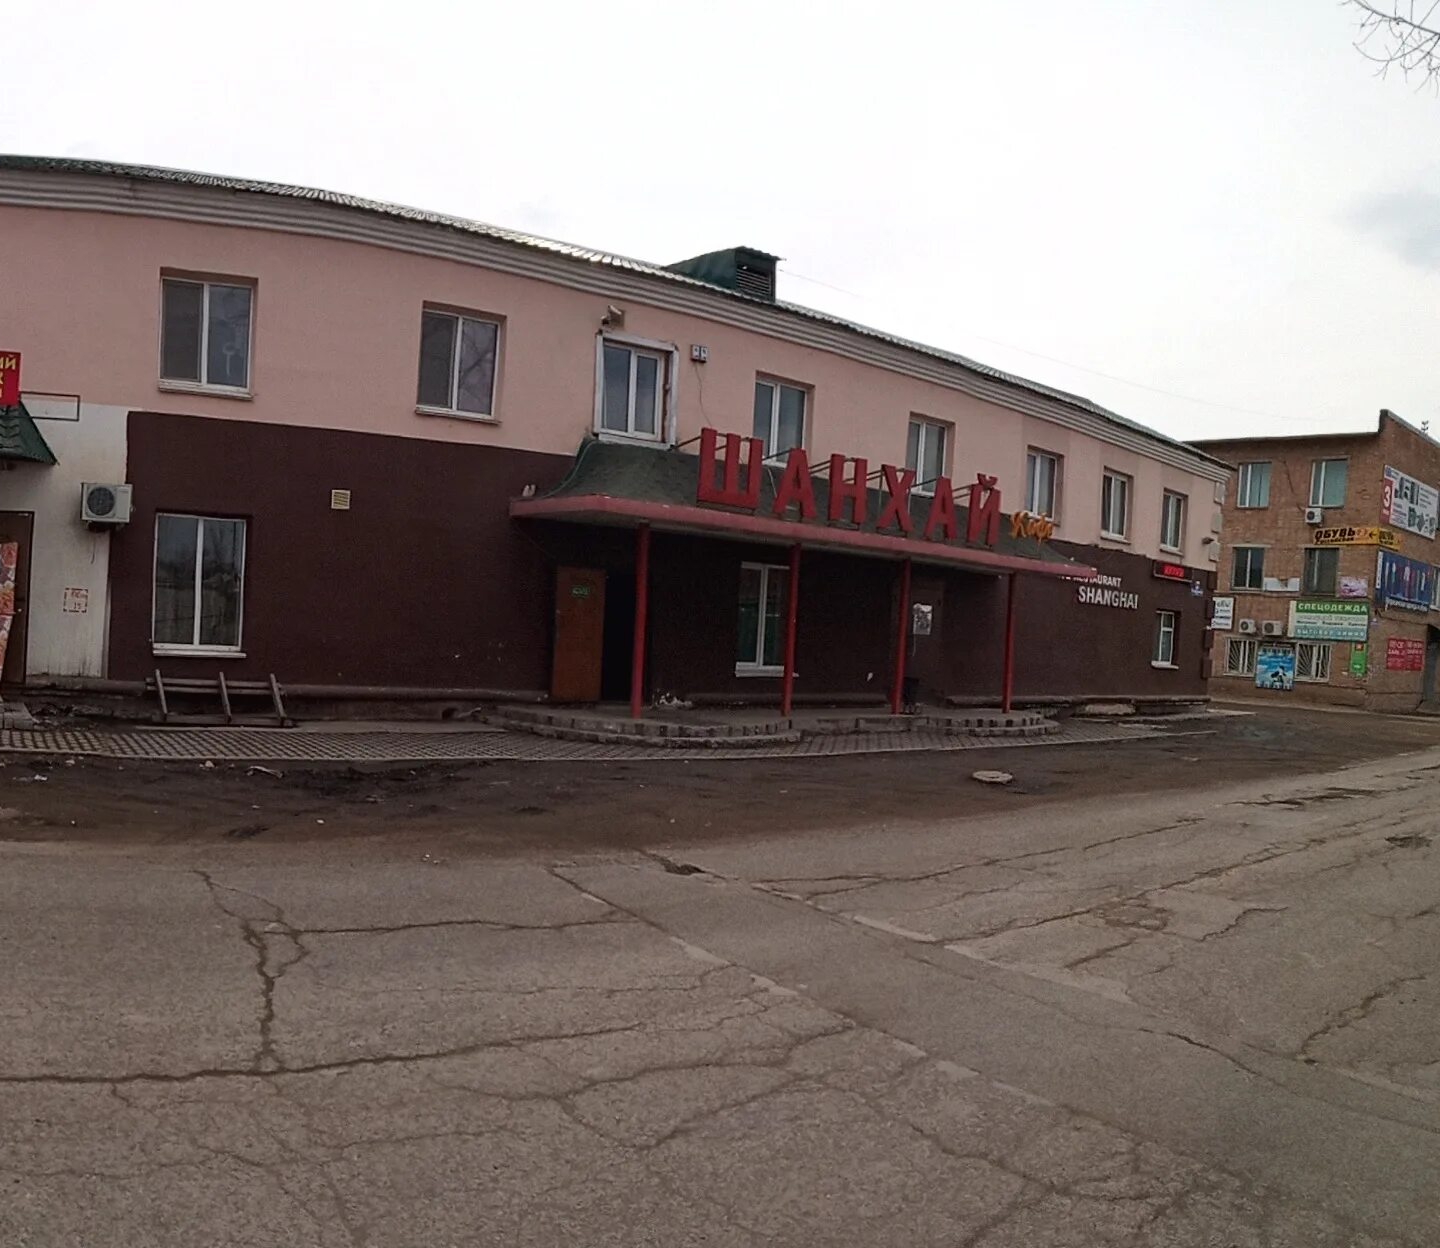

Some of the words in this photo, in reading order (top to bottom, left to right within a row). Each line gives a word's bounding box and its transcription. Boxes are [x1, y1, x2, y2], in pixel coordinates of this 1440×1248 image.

[696, 427, 1001, 547] ШАНХАЙ
[1314, 527, 1355, 540] ОБУВЬ
[1078, 585, 1139, 610] SHANGHAI
[1298, 603, 1367, 612] СПЕЦОДЕЖДА
